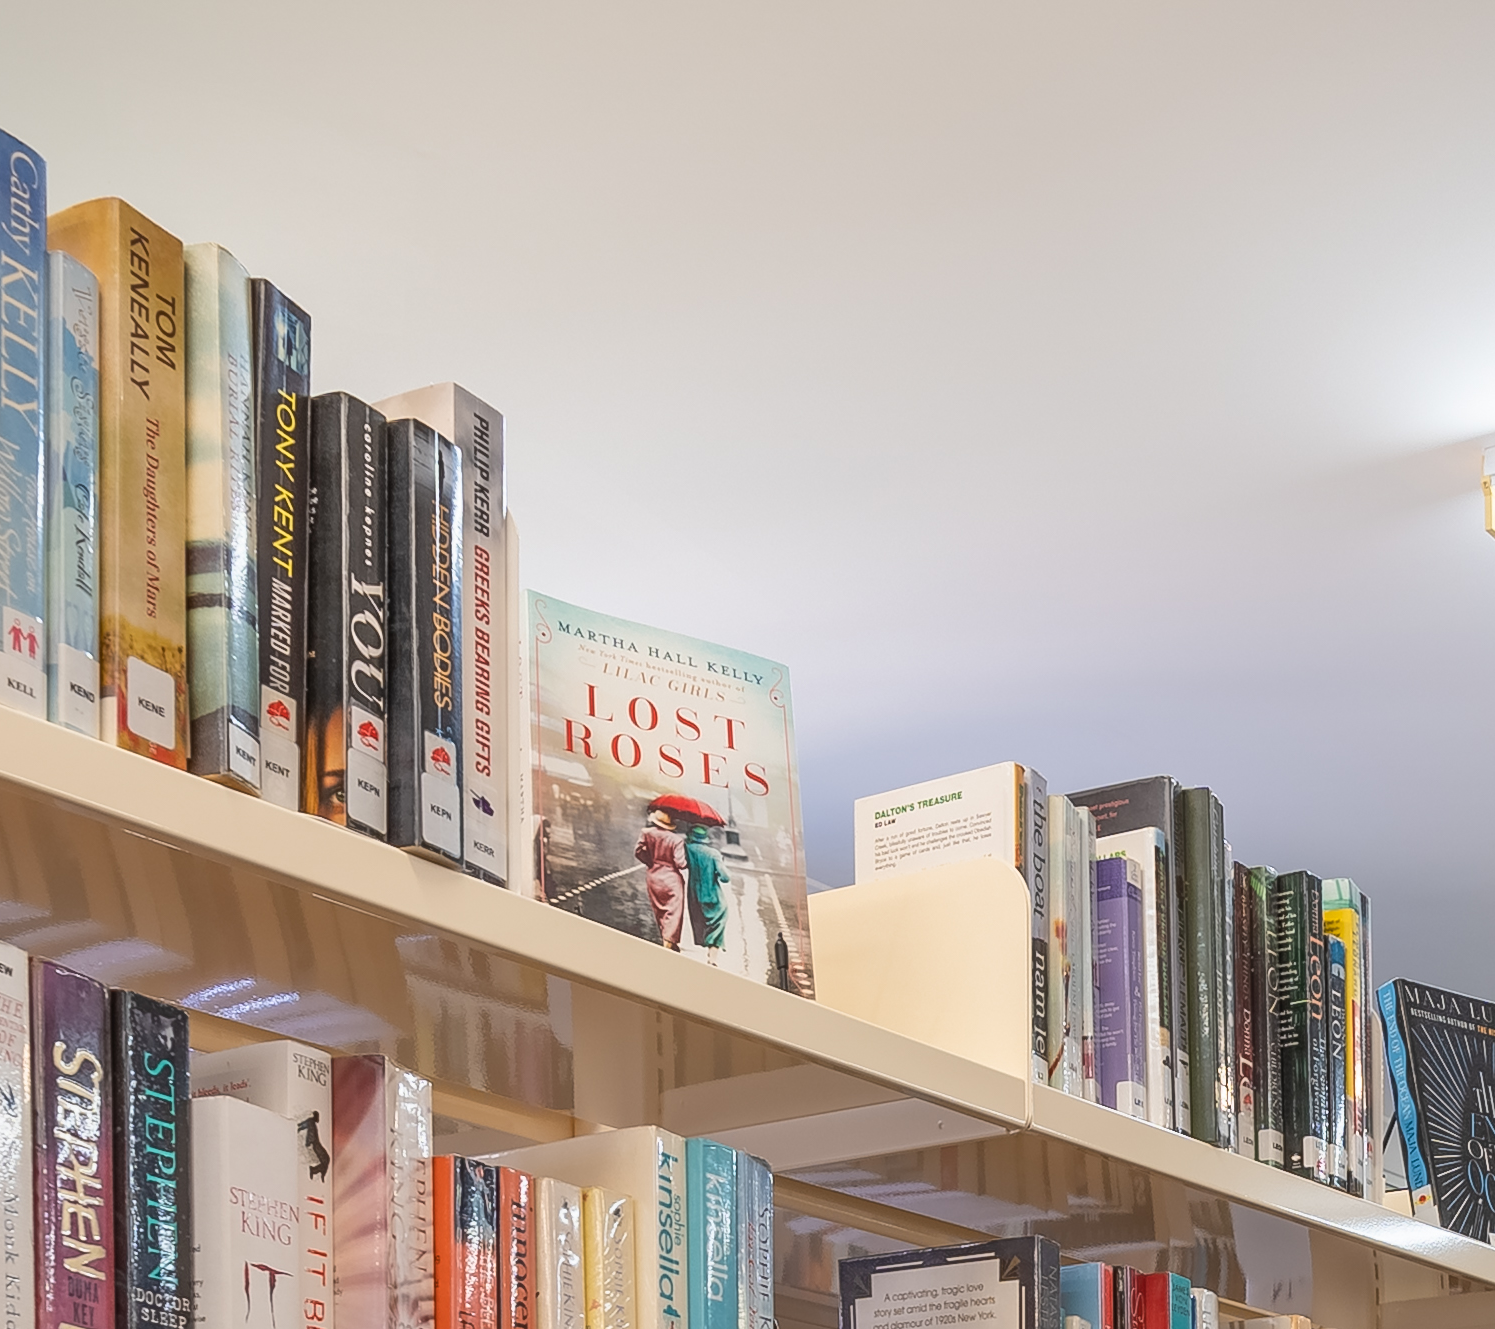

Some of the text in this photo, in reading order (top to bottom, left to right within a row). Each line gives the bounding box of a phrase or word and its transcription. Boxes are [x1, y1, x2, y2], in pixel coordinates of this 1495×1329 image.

[0, 149, 43, 432] Cathy KELLY
[129, 225, 157, 401] KENEALLY
[154, 294, 176, 371] TOM
[273, 386, 296, 579] TONY KENT
[473, 412, 490, 538] PHILIP KERR
[144, 417, 161, 620] The Daughters of Mars
[350, 573, 385, 709] YOU
[474, 544, 491, 777] GREEKS BEARING GIFTS
[557, 620, 764, 686] MARTHA HALL KELLY
[584, 683, 746, 752] LOST
[563, 717, 770, 797] ROSES
[875, 791, 962, 820] DALTON'S TREASURE
[1033, 854, 1047, 920] boat
[1405, 985, 1460, 1015] MAJA
[658, 1150, 680, 1306] kinsella
[135, 1287, 191, 1314] DOCTOR
[141, 1306, 188, 1329] SLEEP
[925, 1319, 933, 1328] of
